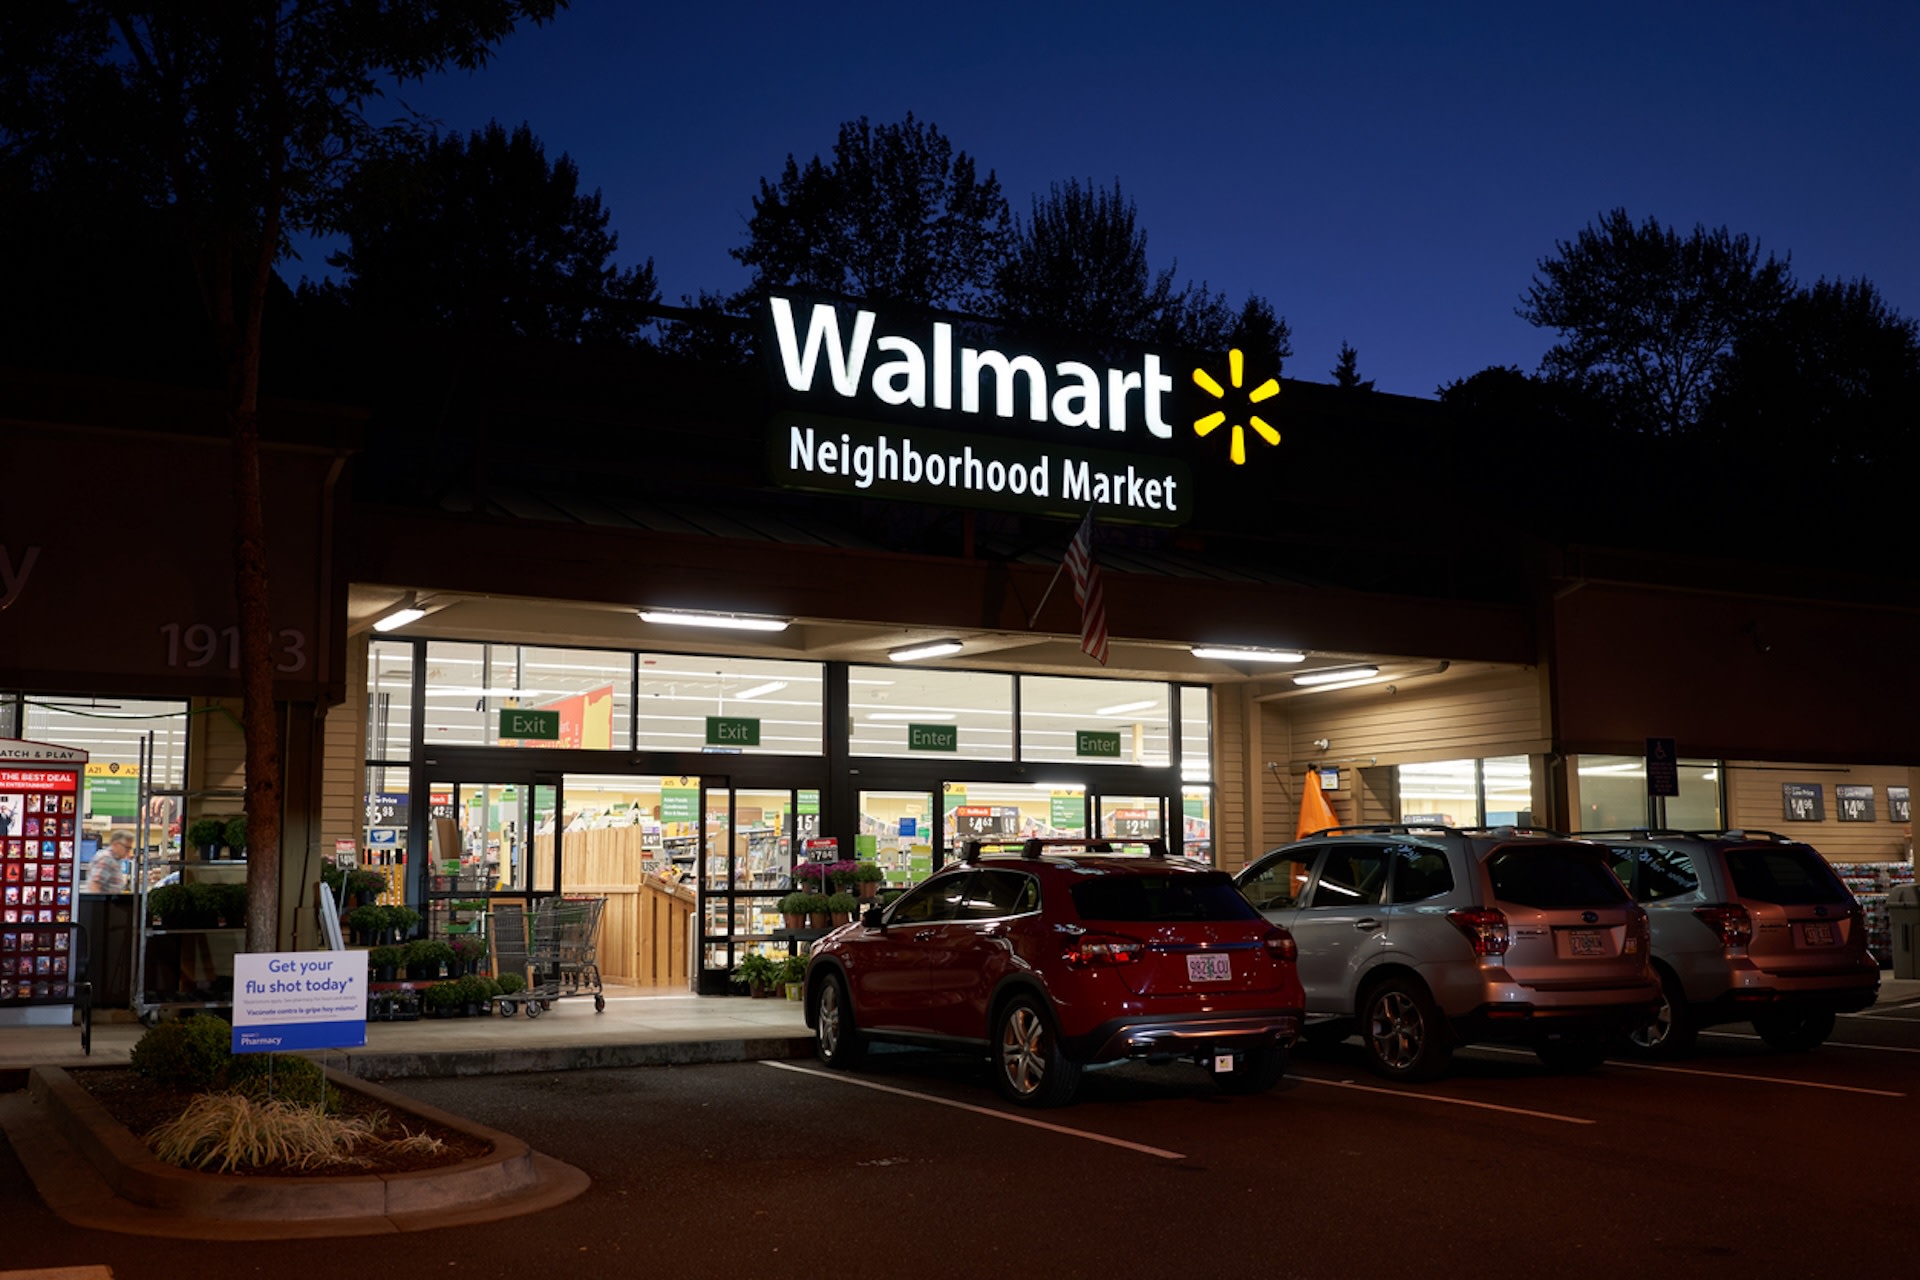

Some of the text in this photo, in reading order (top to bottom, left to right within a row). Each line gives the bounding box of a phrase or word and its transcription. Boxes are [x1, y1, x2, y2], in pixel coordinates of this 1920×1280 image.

[770, 296, 1172, 438] Walmart
[790, 426, 1177, 511] Neighborhood Market
[160, 622, 307, 673] 1913
[513, 715, 546, 733] Exit
[718, 722, 748, 740] Exit
[913, 729, 953, 746] Enter
[1080, 736, 1117, 752] Enter
[1, 772, 72, 782] THE BEST DEAL
[268, 959, 333, 975] Get your
[246, 980, 265, 993] flu
[269, 980, 302, 993] shot
[241, 1037, 282, 1045] Pharmacy
